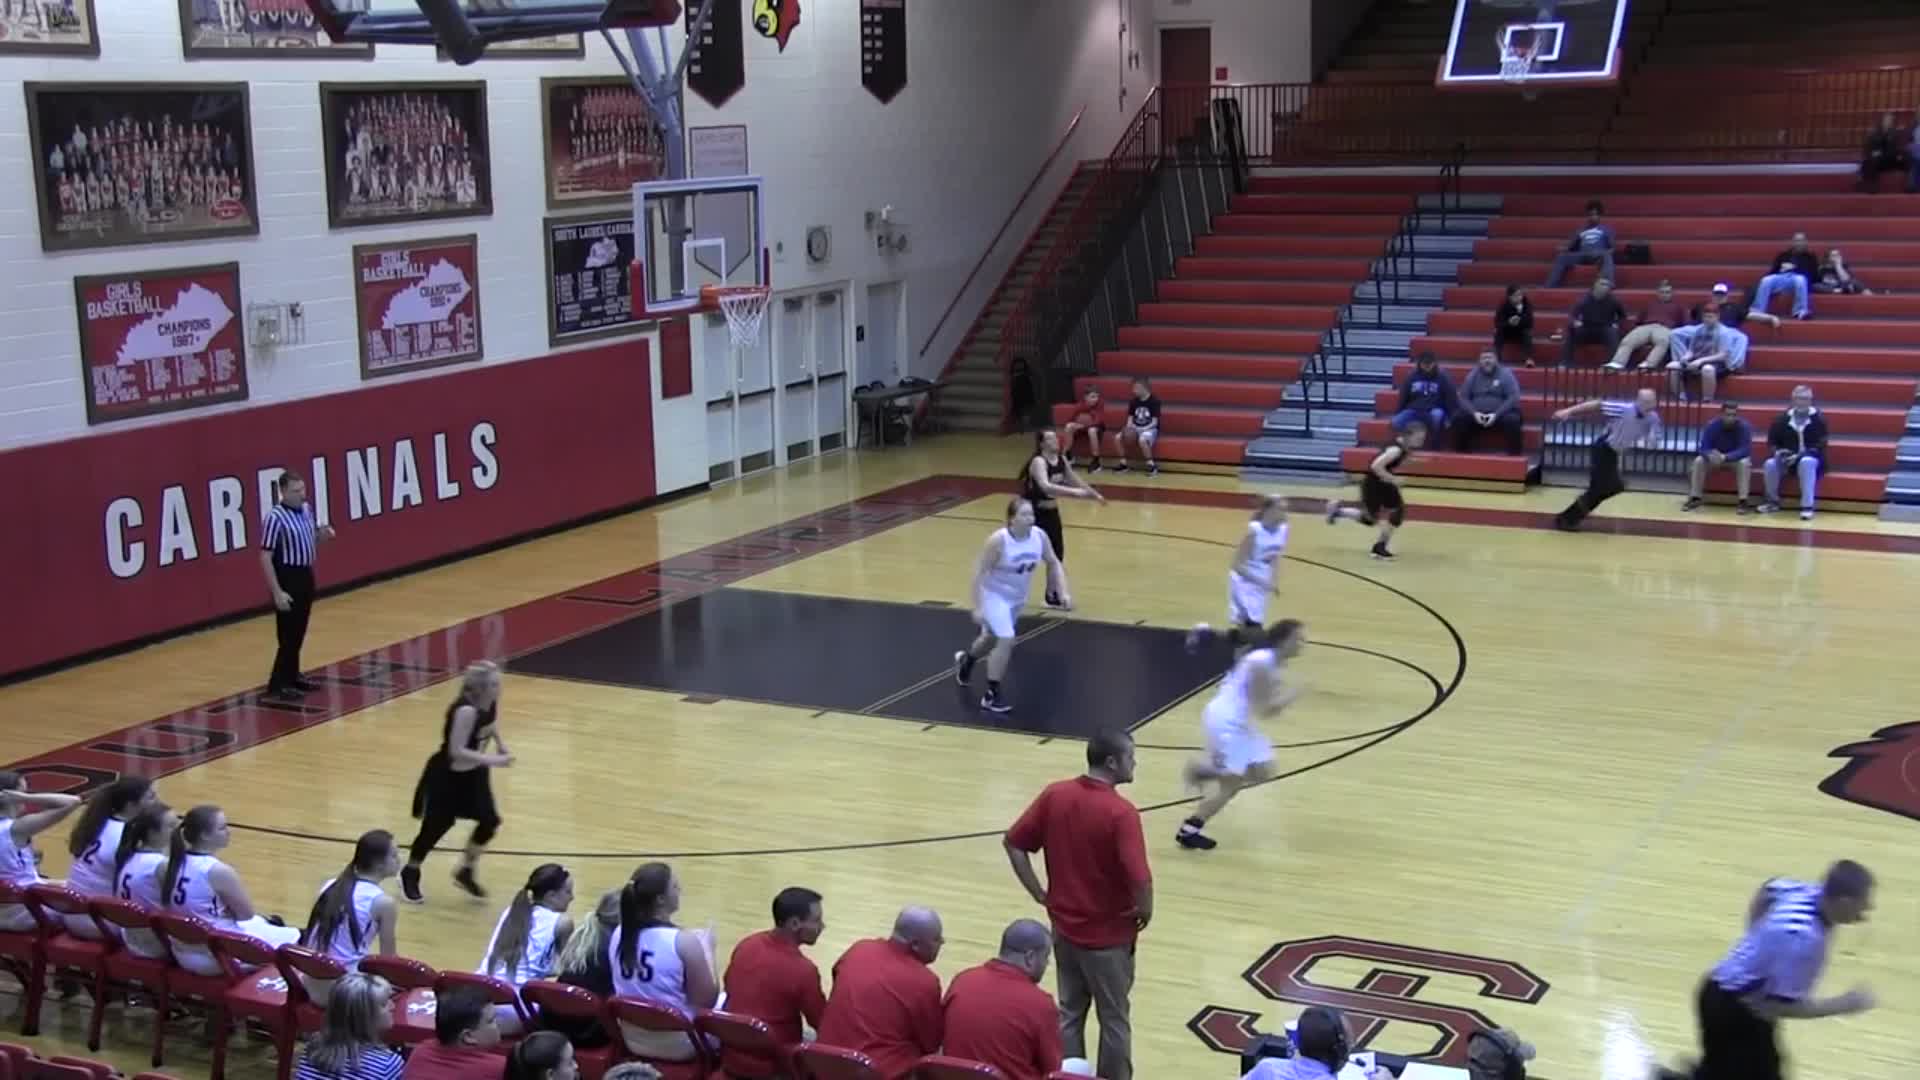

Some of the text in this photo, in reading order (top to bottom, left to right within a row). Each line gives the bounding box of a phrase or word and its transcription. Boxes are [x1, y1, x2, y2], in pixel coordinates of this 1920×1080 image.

[363, 263, 425, 282] BASKETBALL
[106, 281, 143, 300] GIRLS
[87, 296, 163, 320] BASKETBALL
[158, 318, 211, 336] CHAMPIONS
